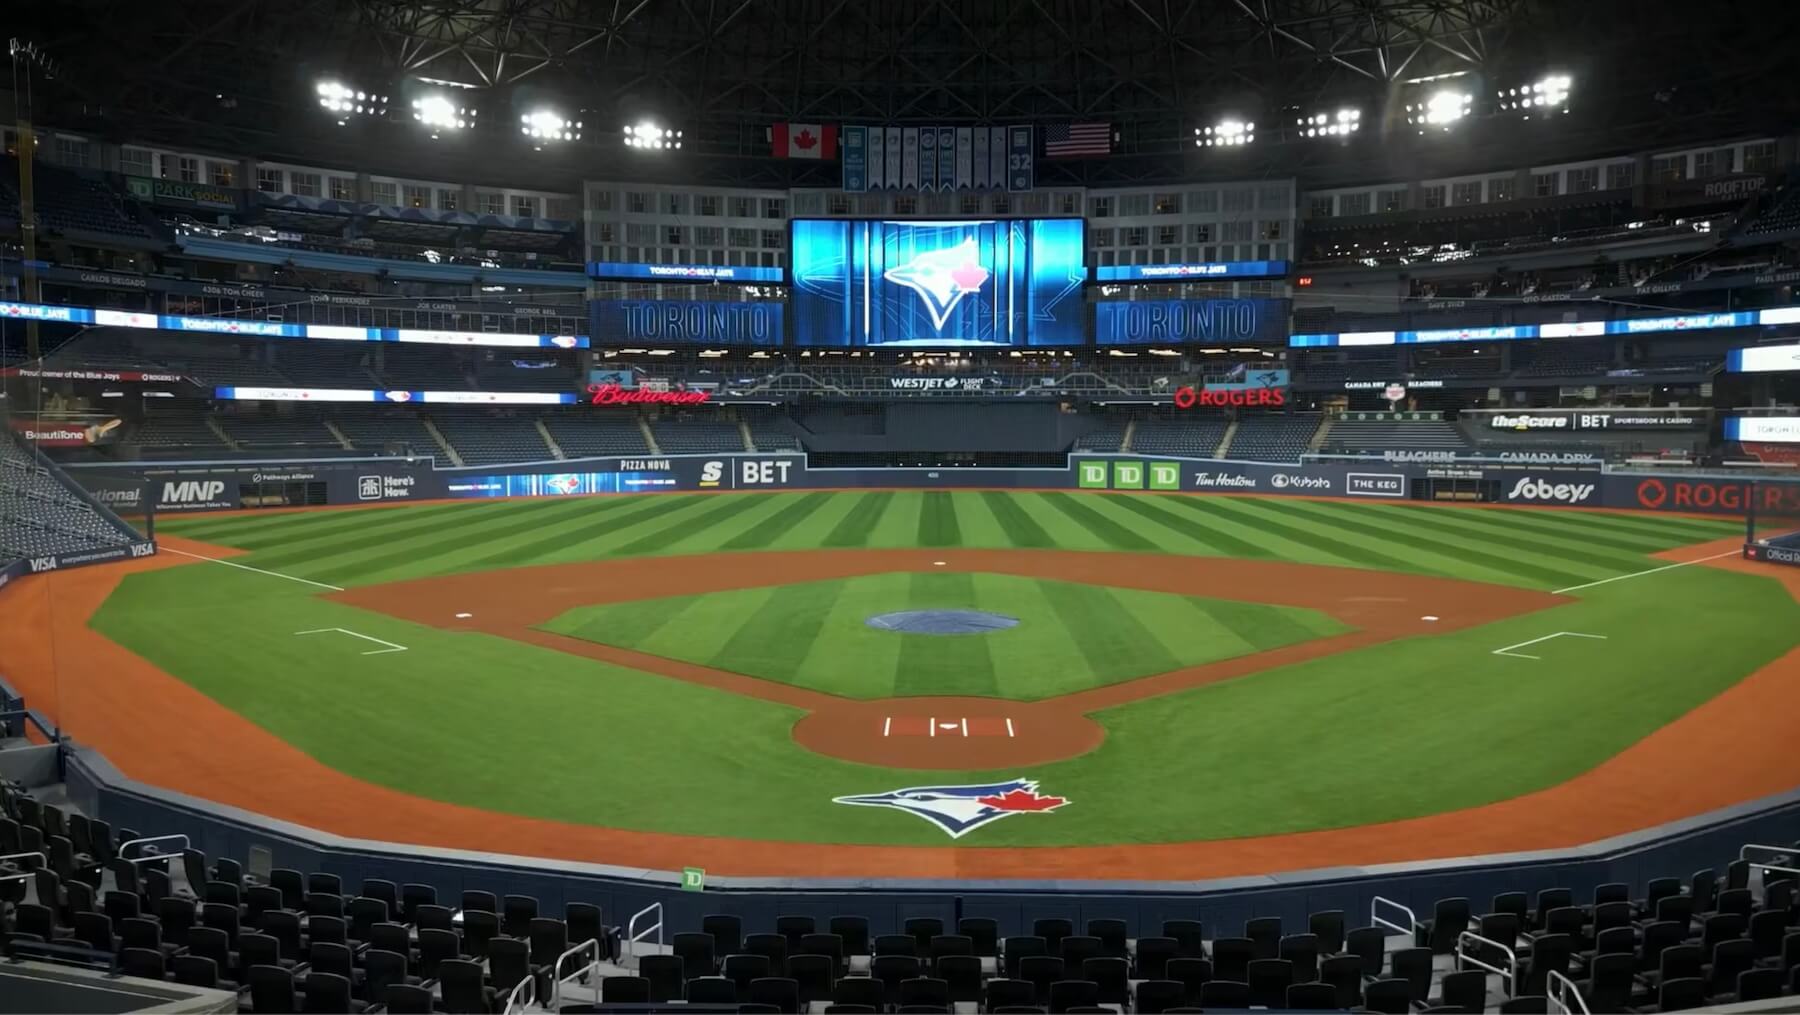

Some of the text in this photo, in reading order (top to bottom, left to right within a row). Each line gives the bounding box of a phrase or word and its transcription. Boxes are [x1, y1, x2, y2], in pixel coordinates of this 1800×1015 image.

[1010, 153, 1031, 170] 32
[129, 181, 150, 197] TD
[154, 181, 194, 197] PARK
[1704, 177, 1766, 197] ROOFTOP
[650, 266, 688, 275] TORONTO
[80, 273, 146, 288] CARLOS DELGADO
[222, 286, 241, 296] TOM
[416, 303, 430, 311] JOE
[621, 301, 769, 343] TORONTO
[1106, 299, 1256, 342] TORONTO
[64, 370, 72, 378] of
[73, 371, 85, 379] the
[86, 371, 102, 379] Blue
[960, 377, 984, 385] FLIGHT
[890, 378, 945, 391] WESTJET
[1344, 381, 1371, 389] CANADA
[1408, 380, 1443, 388] BLEACHERS
[587, 383, 711, 405] Budweiser
[1199, 387, 1285, 406] ROGERS
[1491, 415, 1567, 428] theScore
[1581, 415, 1610, 428] BET
[25, 430, 84, 440] BeautiTone
[1384, 450, 1456, 462] BLEACHERS
[1500, 451, 1593, 464] CANADA DRY
[620, 459, 670, 471] PIZZA NOVA
[742, 460, 792, 484] BET
[262, 474, 290, 482] Pathways
[384, 475, 415, 487] Here's
[1082, 465, 1105, 483] TD
[1117, 466, 1140, 484] TD
[1152, 466, 1176, 484] TD
[1194, 472, 1256, 487] Tim Hortons
[1290, 475, 1331, 489] Kubota
[1353, 479, 1398, 489] THE KEG
[161, 481, 225, 503] MNP
[384, 487, 409, 498] How.
[1508, 477, 1595, 503] Sobeys
[130, 543, 154, 558] VISA
[29, 556, 57, 572] VISA
[684, 871, 702, 886] TD
